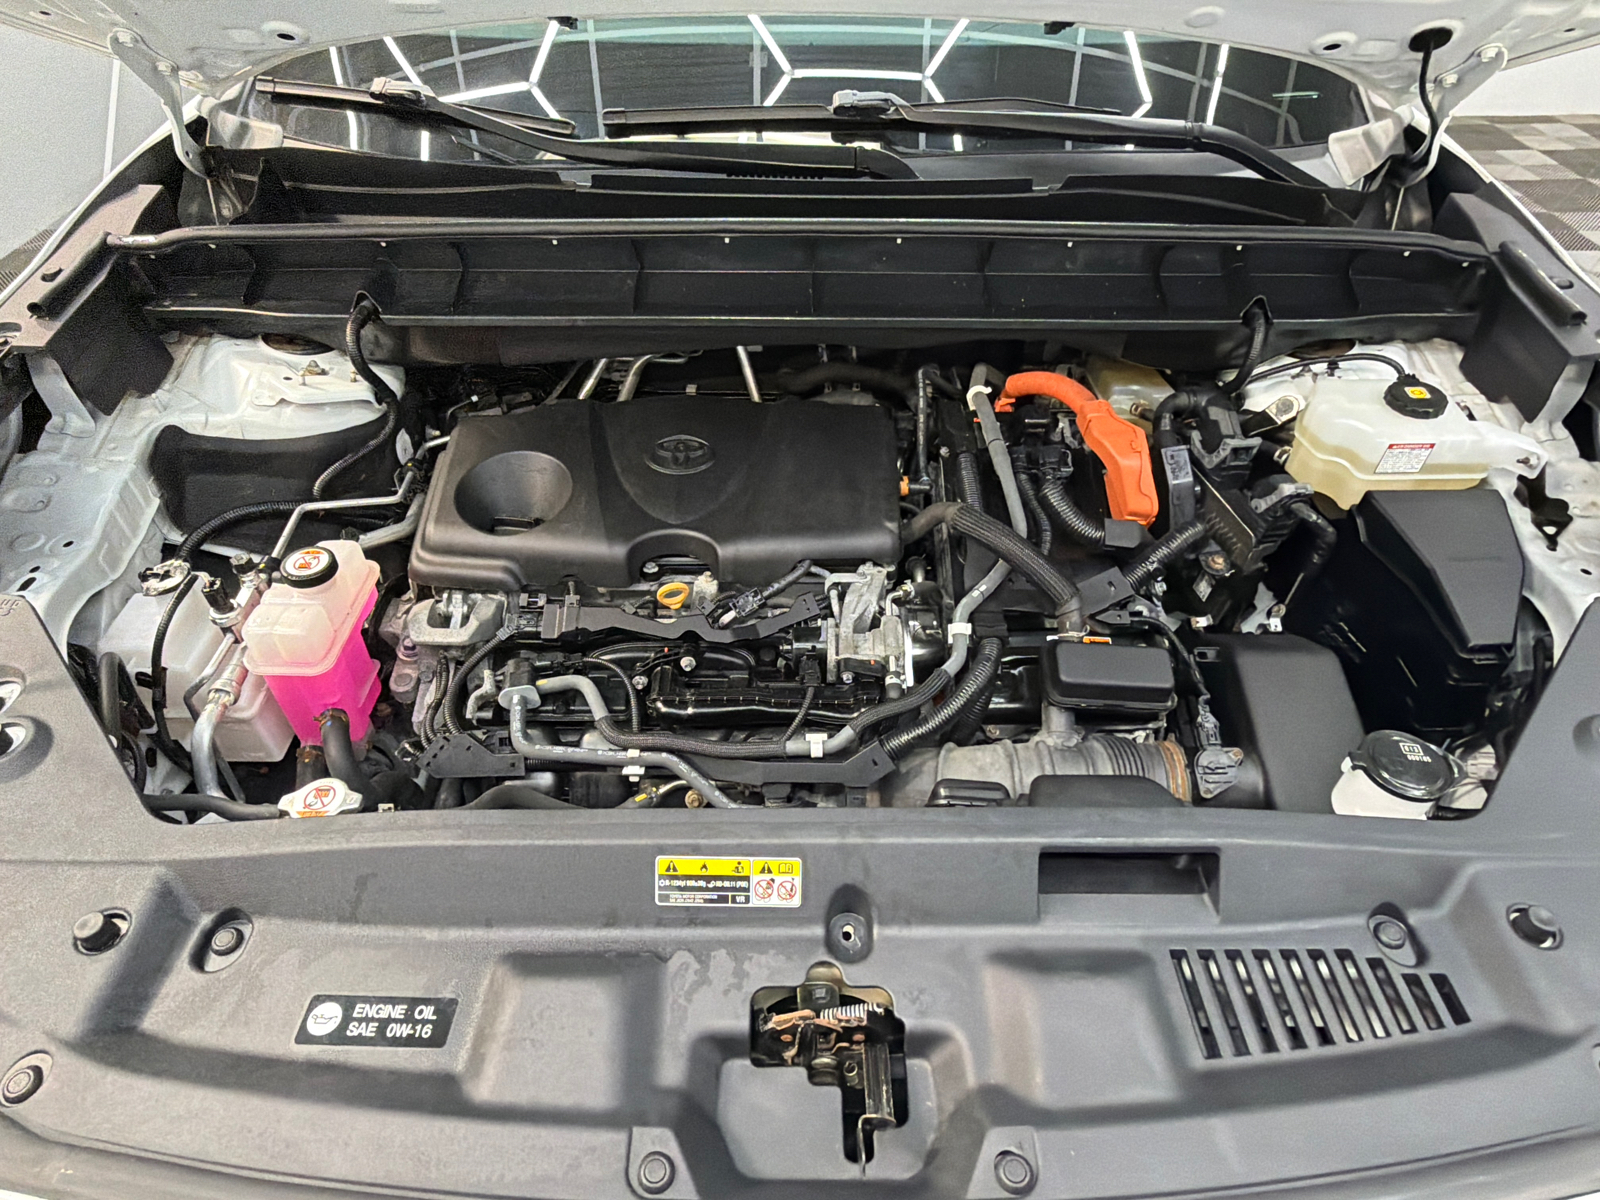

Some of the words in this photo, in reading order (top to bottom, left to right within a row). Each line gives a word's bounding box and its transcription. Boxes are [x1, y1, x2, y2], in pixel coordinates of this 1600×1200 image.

[735, 895, 746, 903] VR
[352, 1003, 408, 1019] ENGINE
[413, 1005, 438, 1020] OIL
[346, 1021, 379, 1037] SAE
[386, 1023, 434, 1039] 0W-16
